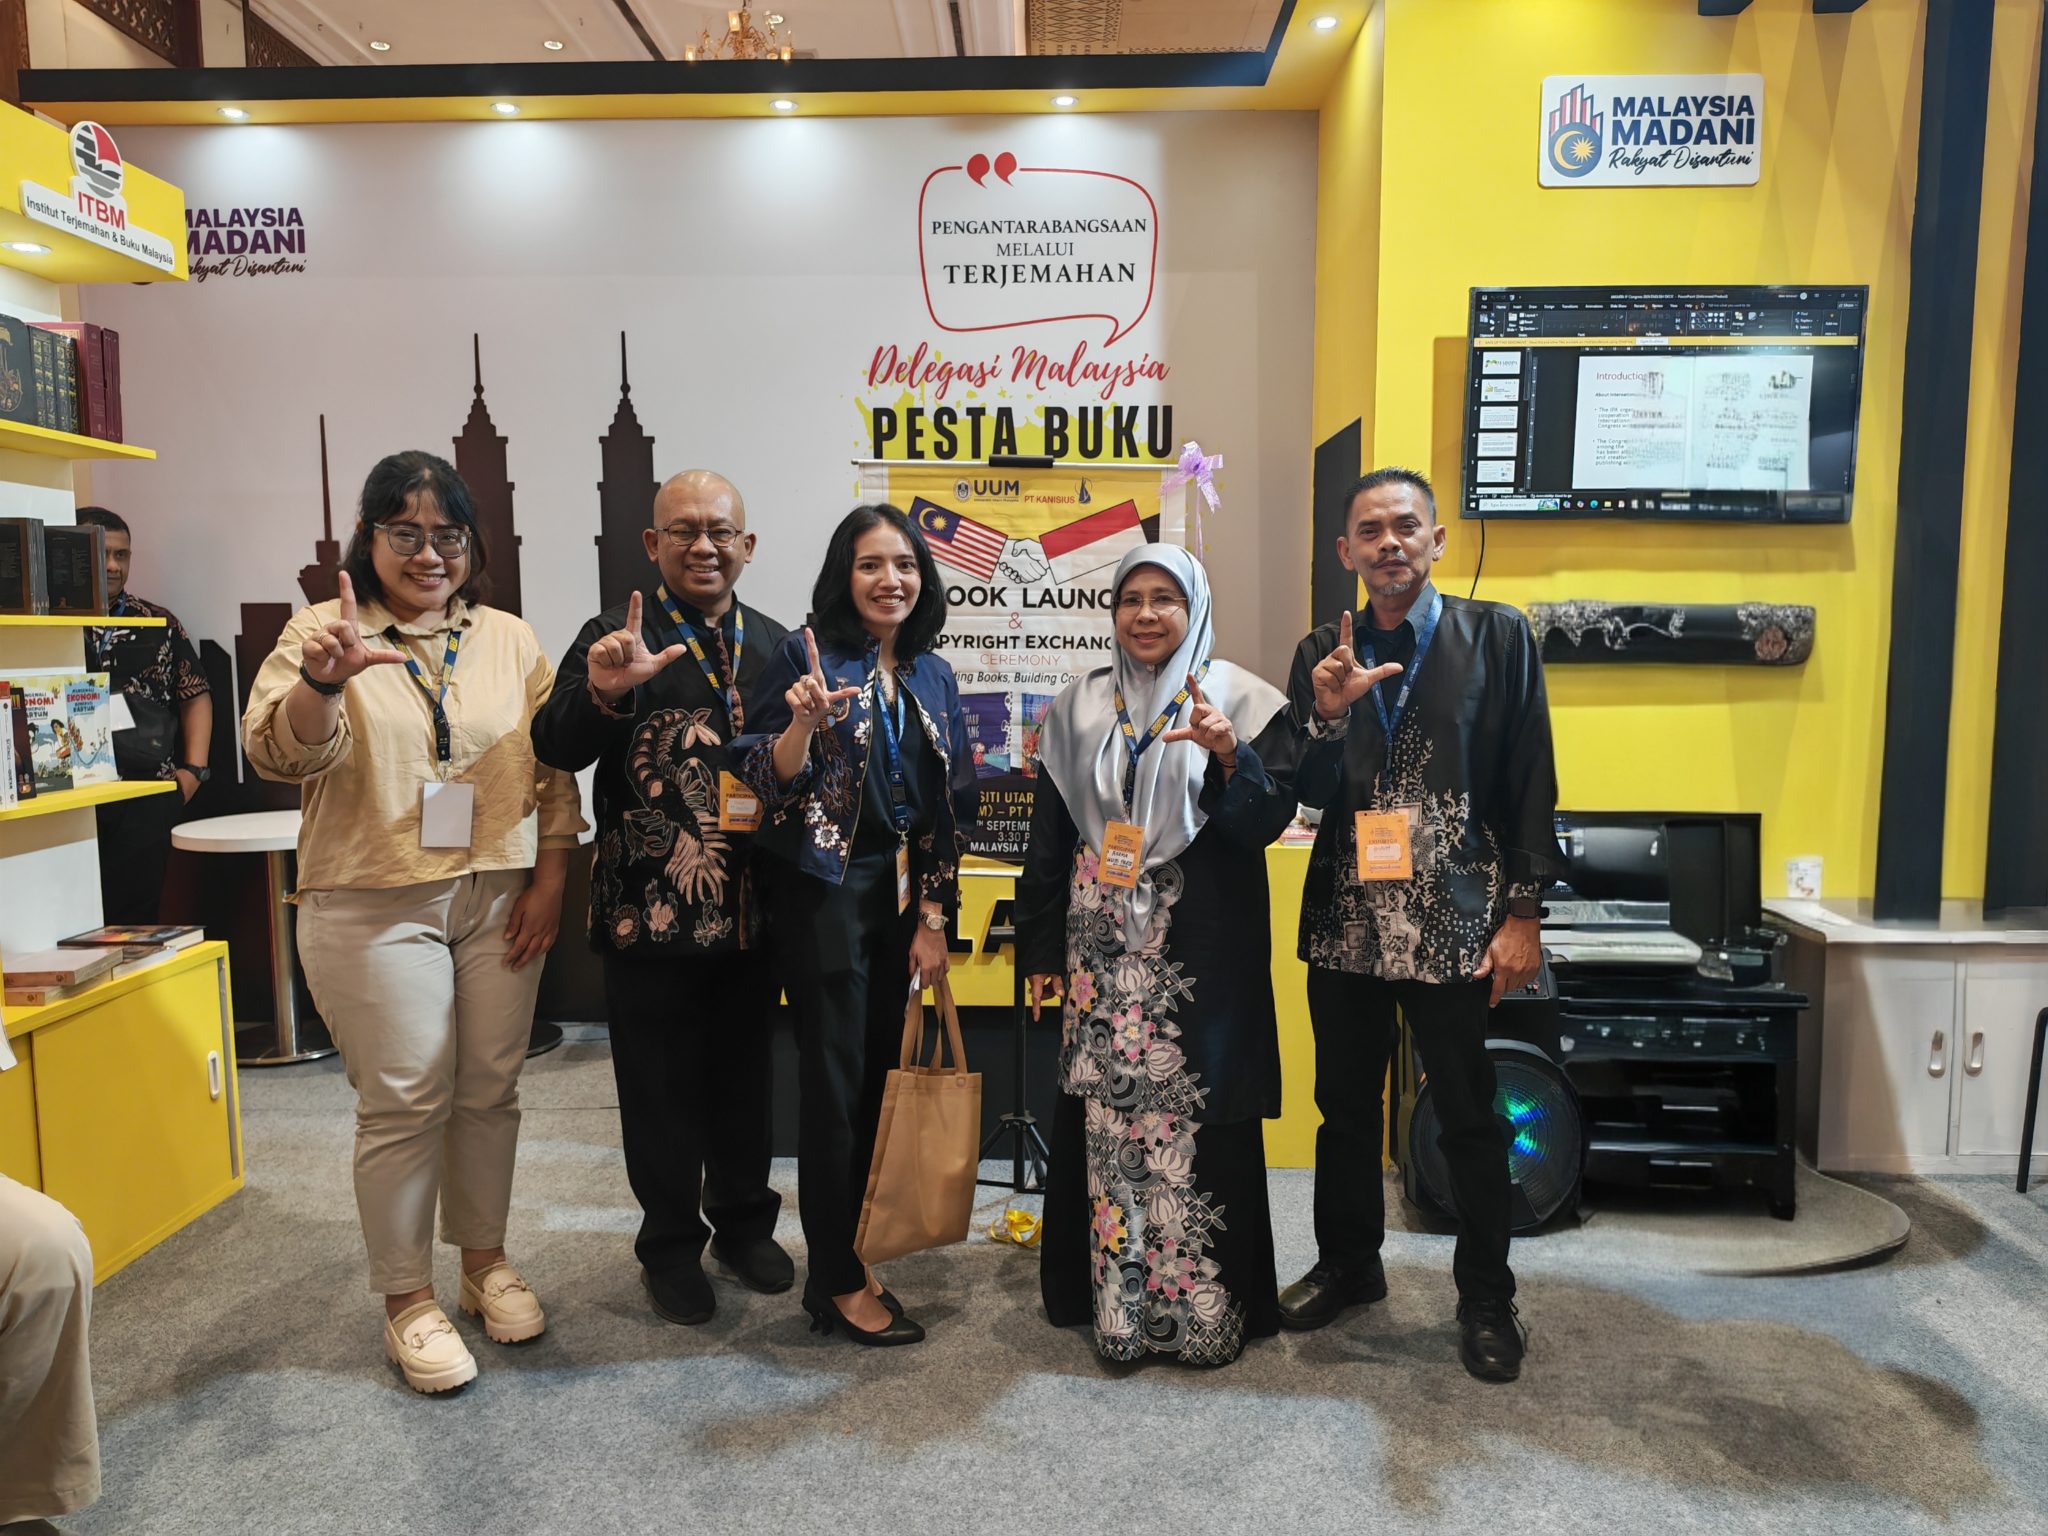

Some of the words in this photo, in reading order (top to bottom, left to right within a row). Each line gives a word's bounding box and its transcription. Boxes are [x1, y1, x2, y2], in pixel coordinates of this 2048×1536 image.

[1612, 95, 1755, 117] MALAYSIA
[1611, 118, 1755, 146] MADANI
[1608, 146, 1674, 176] Rakyat
[1673, 145, 1755, 170] Disantuni
[78, 191, 126, 231] ITBM
[26, 195, 59, 218] Institut
[60, 210, 110, 239] Terjemahan
[112, 231, 119, 243] &
[120, 234, 140, 252] Buku
[141, 243, 173, 265] Malaysia
[931, 218, 1147, 235] PENGANTARABANGSAAN
[996, 242, 1074, 257] MELALUI
[231, 254, 307, 277] Disantuni
[943, 263, 1136, 289] TERJEMAHAN
[867, 341, 1002, 400] Delegasi
[1010, 340, 1171, 400] Malaysia
[872, 406, 1018, 460] PESTA
[1044, 405, 1173, 459] BUKU
[974, 480, 1019, 496] UUM
[1036, 496, 1076, 504] KANISIUS
[945, 585, 1008, 607] OOK
[1008, 611, 1023, 629] &
[935, 634, 1020, 649] PYRIGHT
[980, 653, 1061, 666] CEREMONY
[977, 671, 1011, 684] Books,
[1014, 672, 1057, 686] Building
[66, 693, 101, 703] EKONOMI
[1004, 791, 1034, 804] UTAR
[1009, 806, 1023, 817] PT
[998, 831, 1021, 842] 3:30
[970, 841, 1019, 853] MALAYSIA
